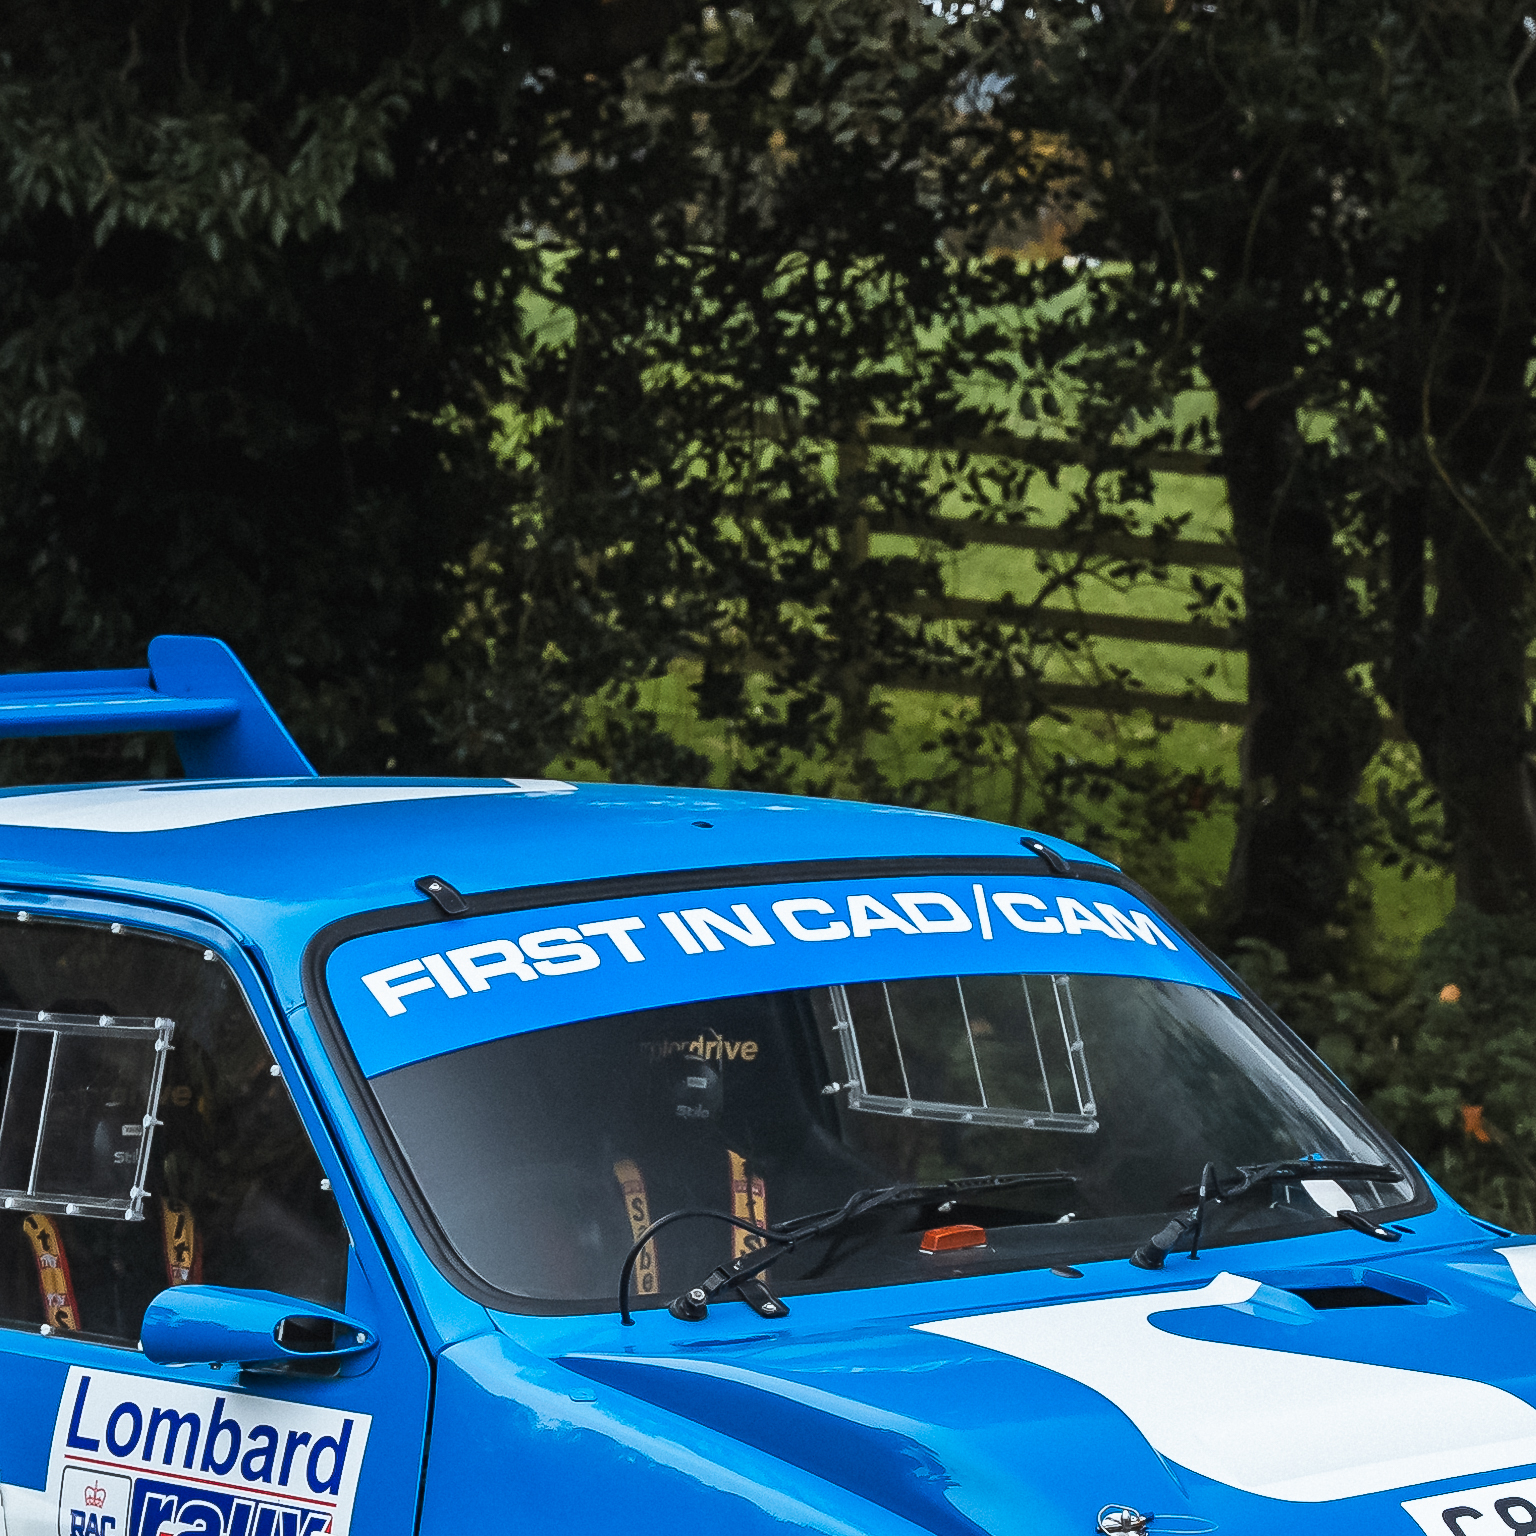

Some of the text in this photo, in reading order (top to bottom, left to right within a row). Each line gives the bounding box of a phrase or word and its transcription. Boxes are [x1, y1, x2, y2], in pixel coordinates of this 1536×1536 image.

[361, 883, 1179, 1018] FIRST IN CAD/CAM
[114, 1148, 140, 1164] Stil
[65, 1375, 354, 1496] Lombard
